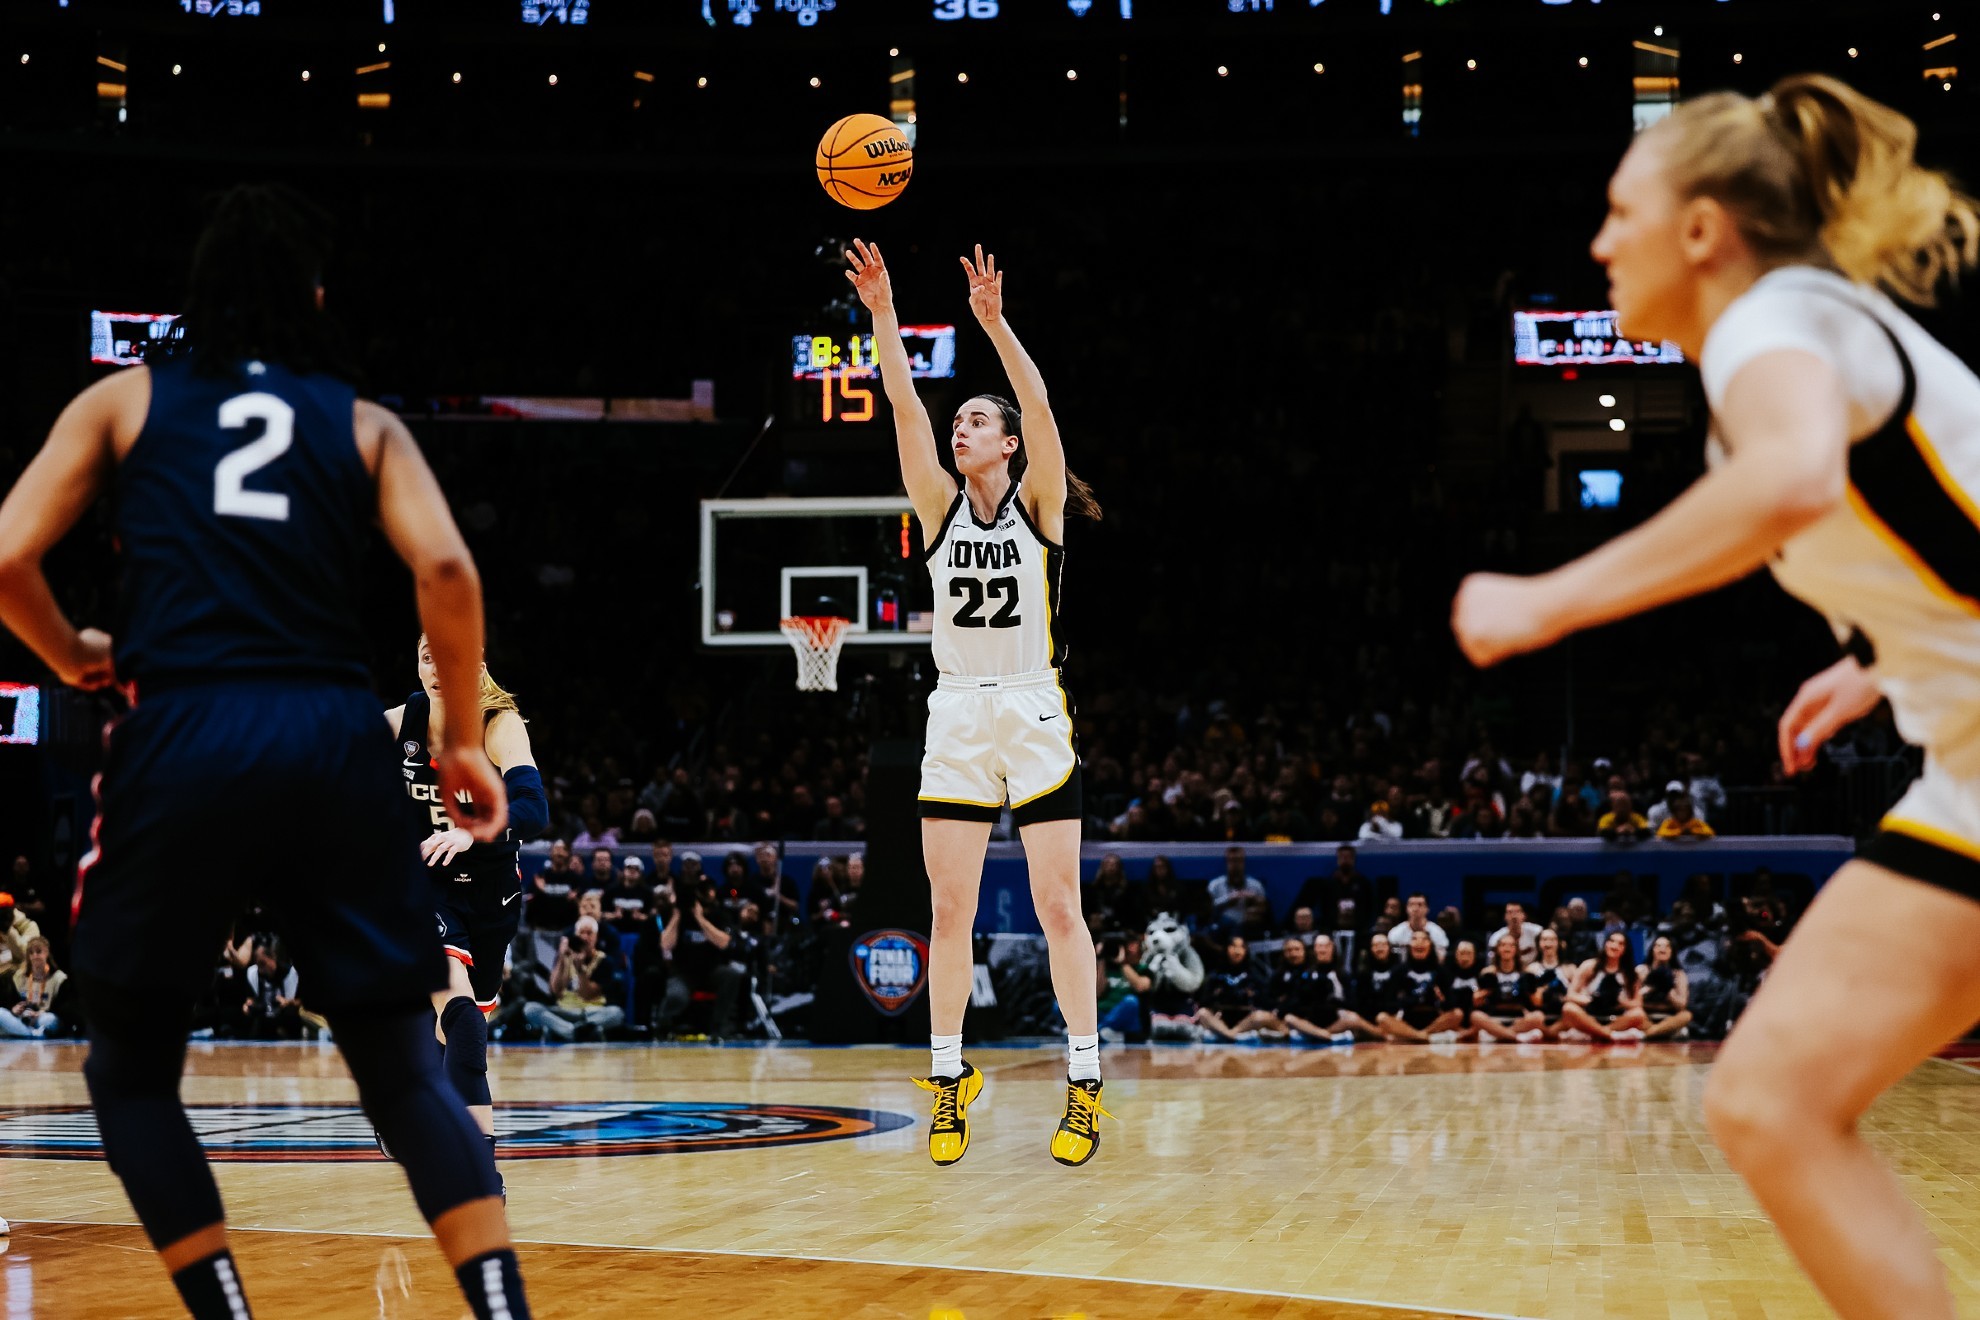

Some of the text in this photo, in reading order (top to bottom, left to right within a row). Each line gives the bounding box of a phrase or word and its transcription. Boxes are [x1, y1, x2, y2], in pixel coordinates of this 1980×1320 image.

[933, 0, 999, 20] 36
[864, 138, 911, 159] Wilso
[822, 367, 874, 423] 15
[214, 391, 295, 522] 2
[947, 538, 1022, 570] IOWA
[948, 575, 1022, 629] 22
